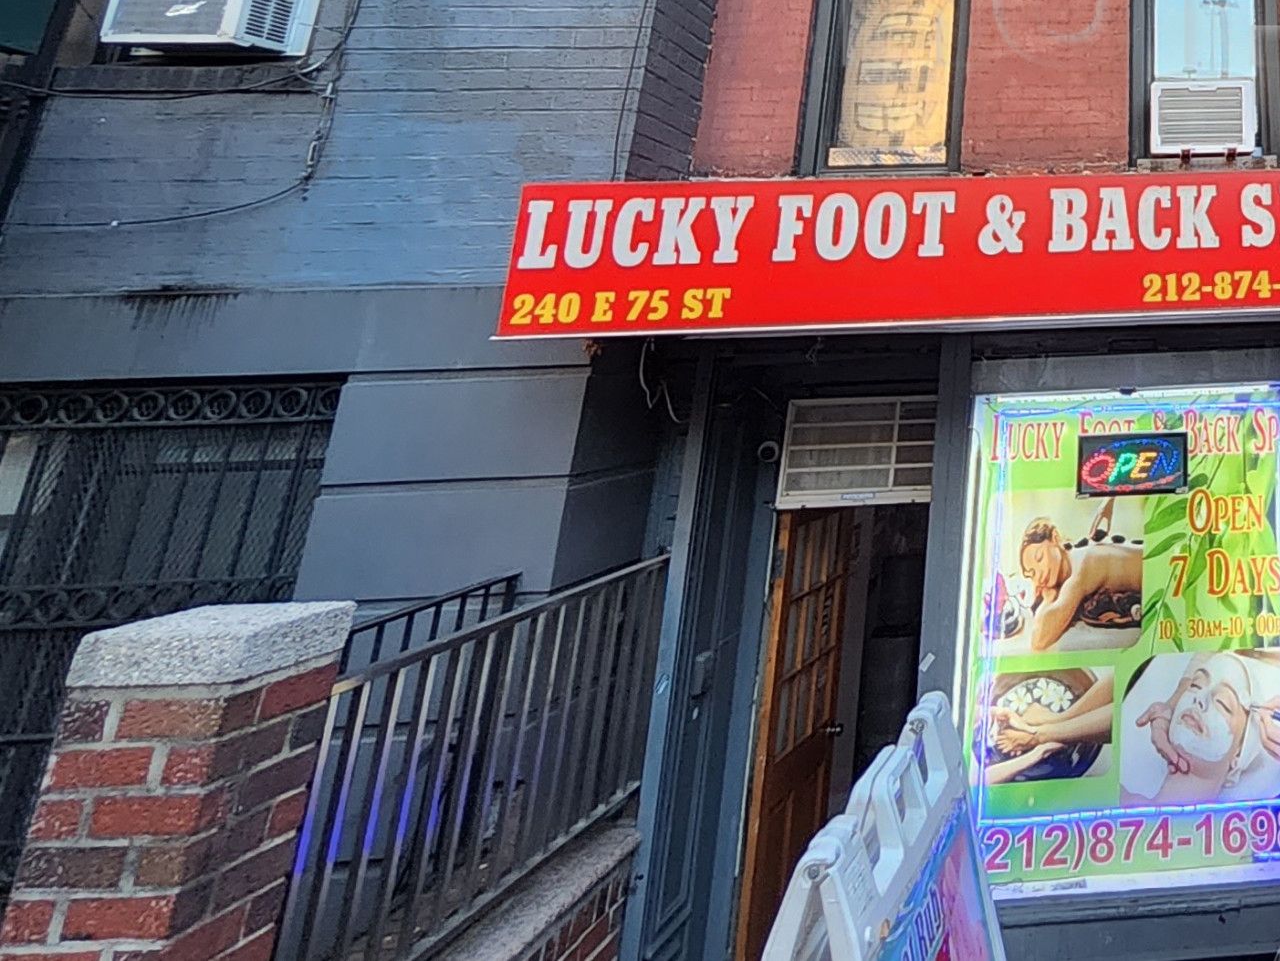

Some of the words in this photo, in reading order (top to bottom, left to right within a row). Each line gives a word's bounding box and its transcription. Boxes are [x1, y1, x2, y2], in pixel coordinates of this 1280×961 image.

[517, 196, 754, 269] LUCKY
[772, 191, 956, 262] FOOT
[977, 195, 1026, 255] &
[1048, 184, 1219, 252] BACK
[509, 293, 580, 325] 240
[591, 292, 617, 322] E
[626, 290, 669, 321] 75
[681, 288, 731, 319] ST
[1081, 448, 1180, 484] OPEN
[1169, 555, 1189, 597] 7
